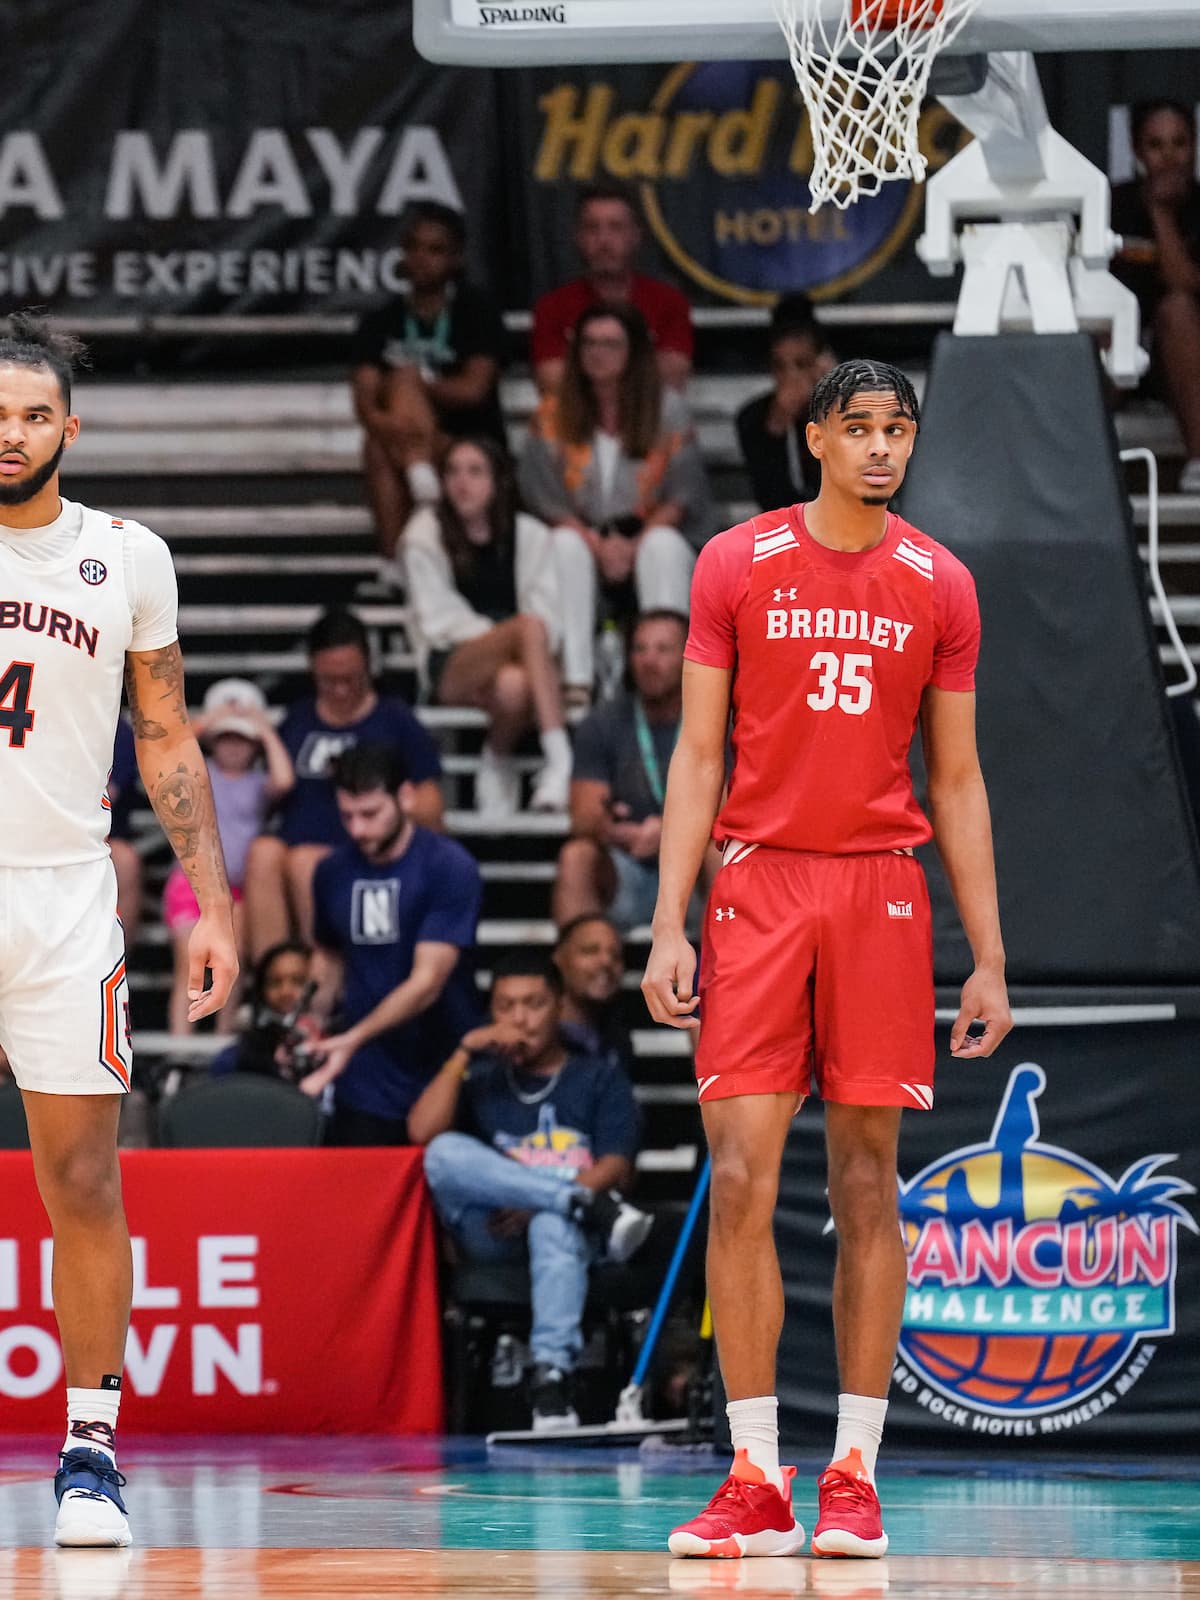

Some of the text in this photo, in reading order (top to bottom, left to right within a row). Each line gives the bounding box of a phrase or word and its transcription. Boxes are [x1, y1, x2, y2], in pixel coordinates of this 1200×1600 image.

[479, 4, 566, 25] SPALDING
[534, 79, 780, 180] Hard
[104, 125, 465, 219] MAYA
[714, 208, 850, 242] HOTEL
[111, 246, 412, 296] EXPERIENC
[81, 562, 106, 585] SEC
[766, 608, 914, 653] BRADLEY
[806, 651, 873, 716] 35
[906, 1216, 1171, 1288] ANCUN
[908, 1291, 1147, 1325] HALLENGE
[916, 1388, 970, 1427] ROCK
[972, 1414, 1037, 1437] HOTEL
[1040, 1391, 1117, 1435] RIVIERA
[1114, 1344, 1158, 1396] MAYA
